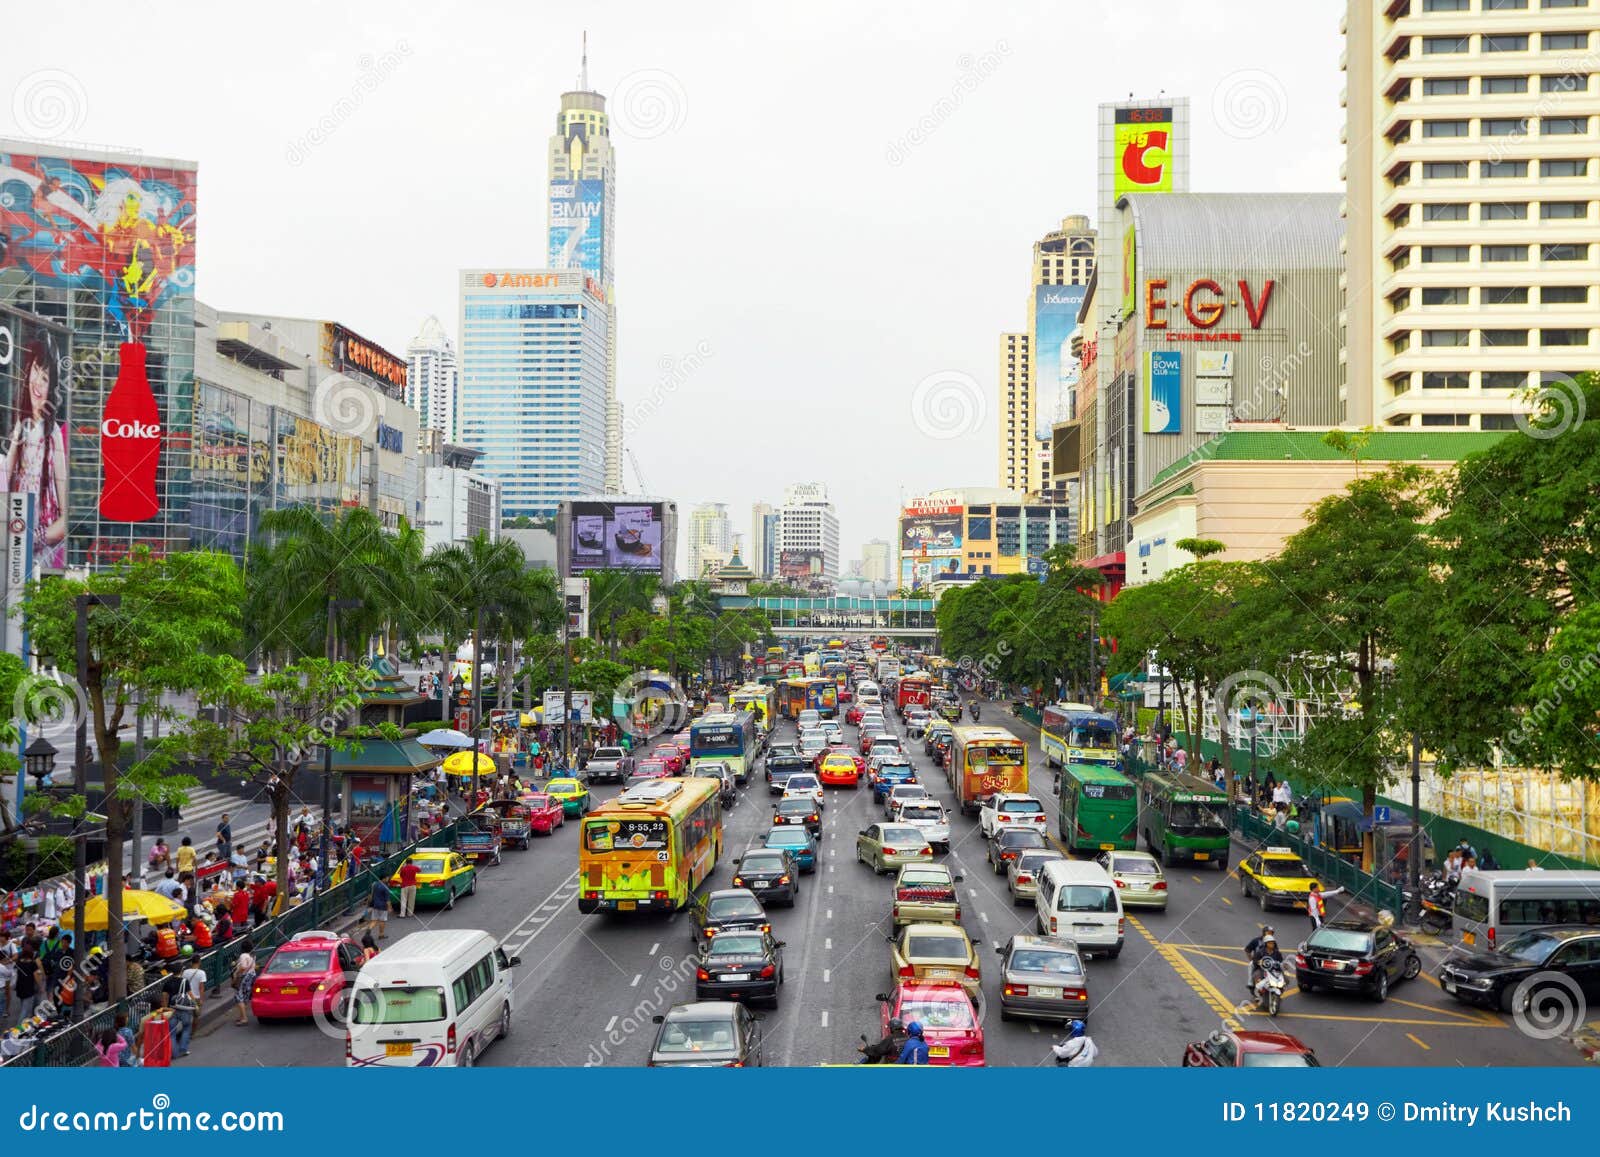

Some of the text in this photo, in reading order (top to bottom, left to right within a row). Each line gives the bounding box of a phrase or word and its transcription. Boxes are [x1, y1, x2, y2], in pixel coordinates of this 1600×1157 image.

[1119, 131, 1149, 148] Big
[551, 201, 601, 217] BMW
[500, 272, 559, 288] Amari
[1153, 361, 1179, 369] BOWL
[102, 419, 160, 439] Coke
[912, 499, 957, 507] PRATUNAM
[658, 852, 668, 860] 21
